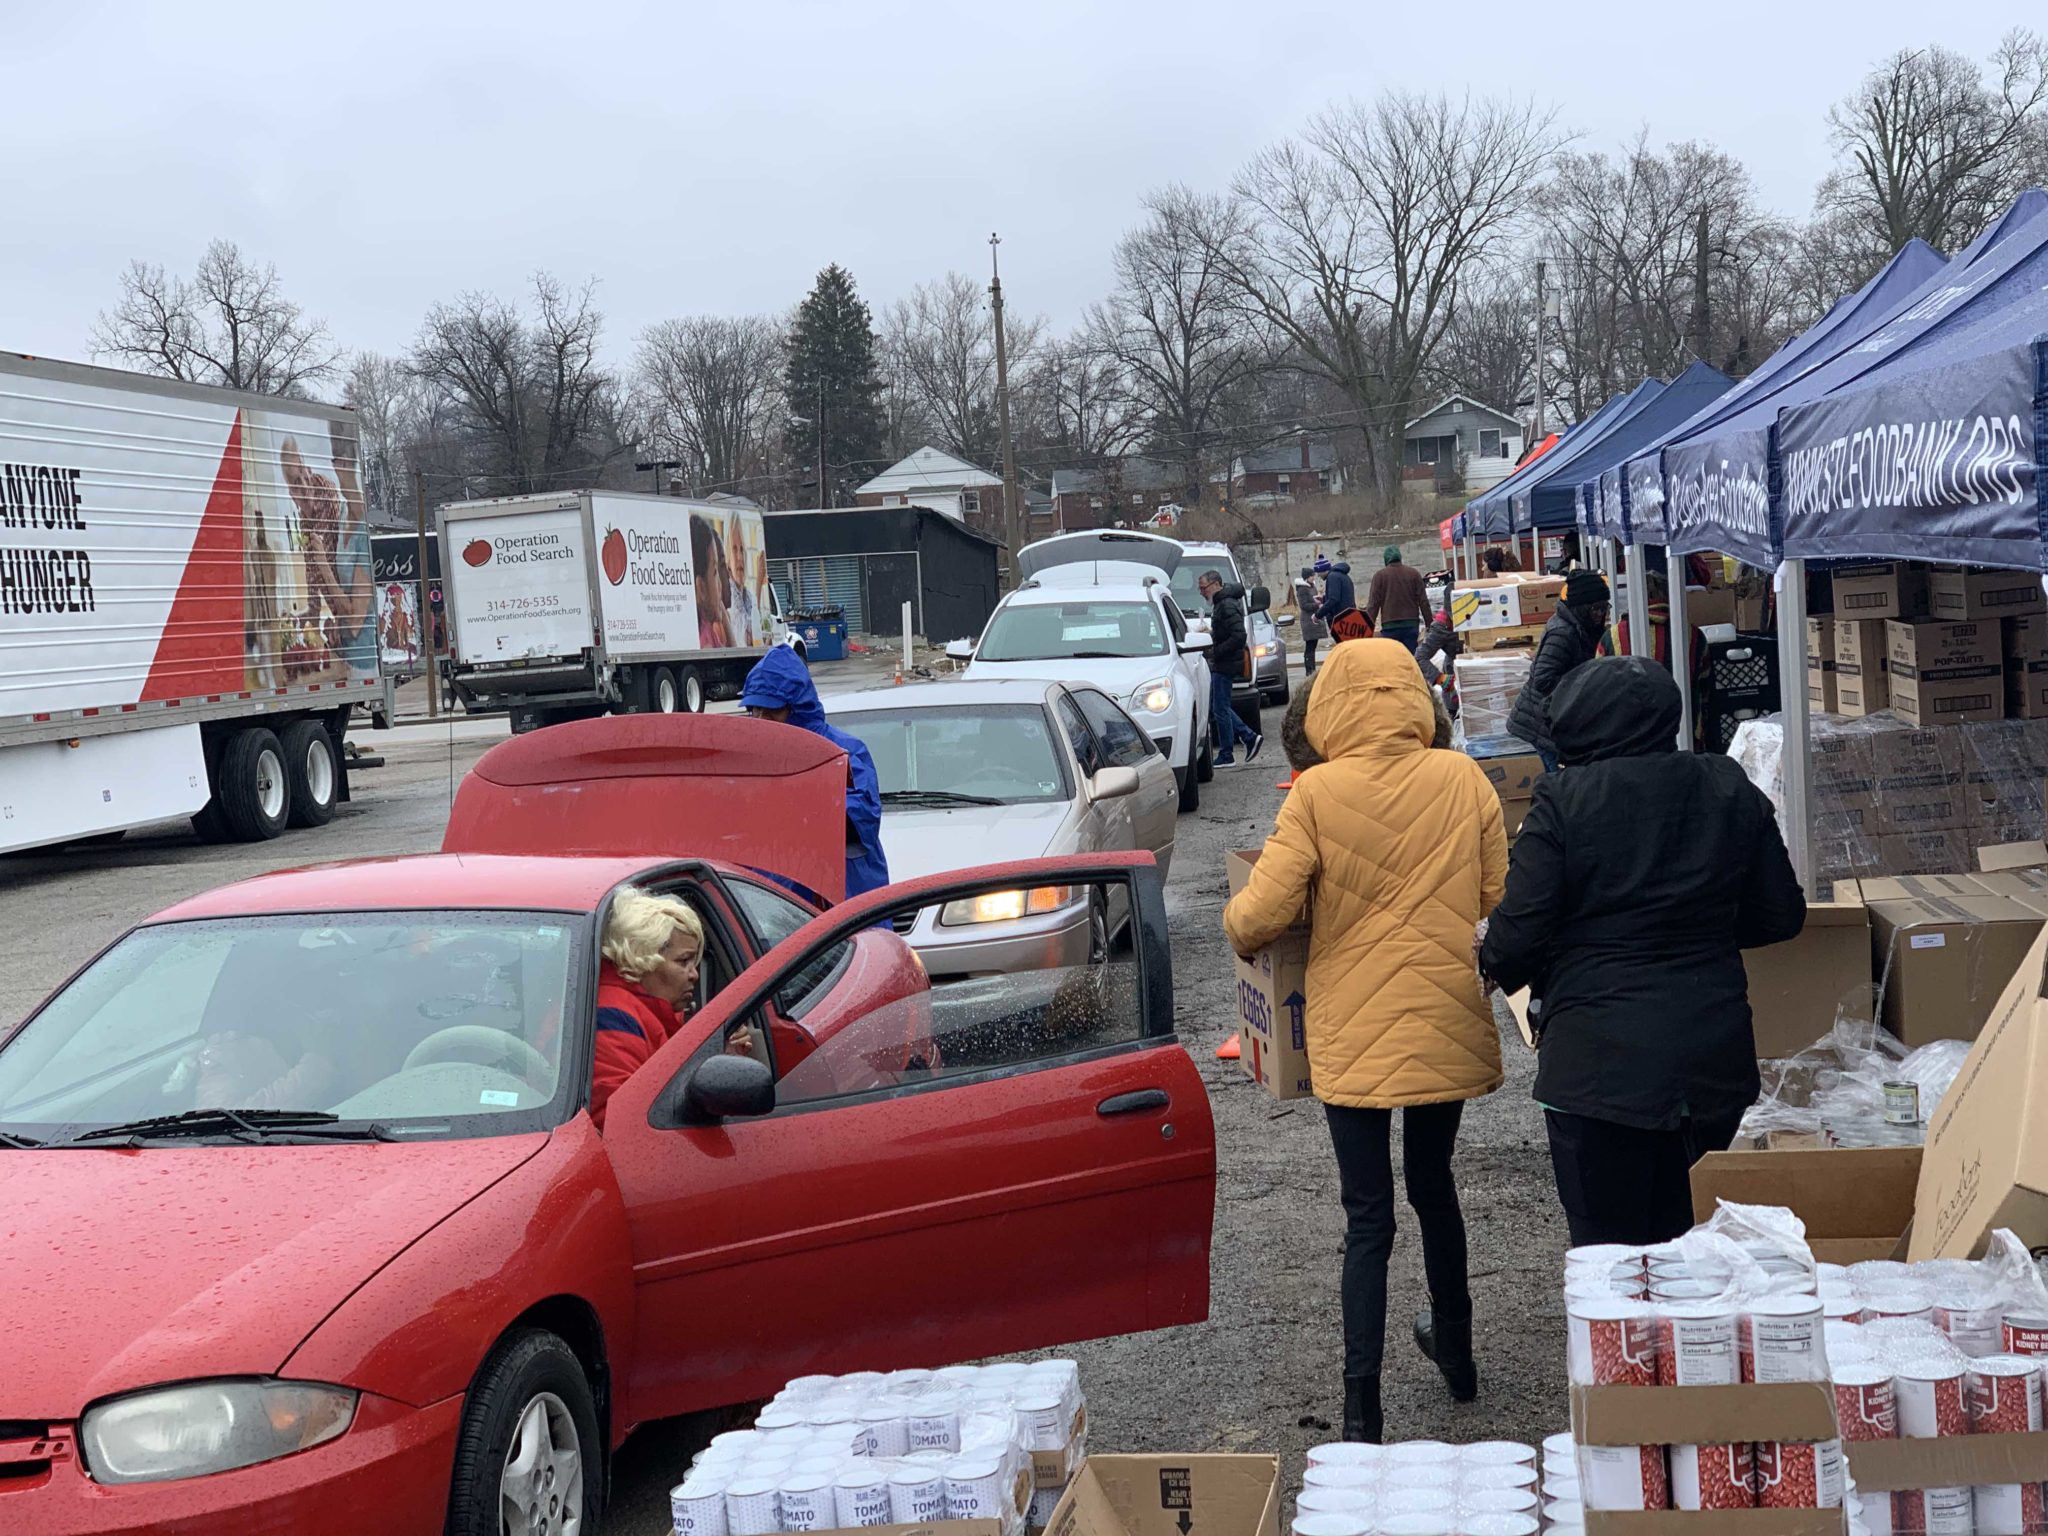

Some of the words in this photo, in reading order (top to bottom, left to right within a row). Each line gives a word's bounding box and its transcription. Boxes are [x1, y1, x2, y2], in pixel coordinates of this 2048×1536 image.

[494, 533, 559, 552] Operation
[628, 528, 680, 560] Operation
[496, 551, 527, 565] Food
[530, 546, 574, 561] Search
[0, 550, 95, 614] HUNGER
[630, 561, 657, 585] Food
[658, 562, 692, 586] Search
[487, 595, 559, 611] 314-726-5355
[467, 606, 581, 624] www.OperationFoodSearch.org
[1337, 620, 1367, 638] SLOW
[1934, 655, 1984, 667] POP-TARTS
[1241, 978, 1267, 1035] EGGS
[1297, 1079, 1312, 1092] KE
[2016, 1340, 2039, 1350] KIDNEY
[2022, 1332, 2040, 1341] DARK
[911, 1433, 950, 1446] TOMATO
[854, 1499, 891, 1518] TOMAT
[912, 1496, 944, 1514] TOMA
[948, 1498, 978, 1510] MATO
[784, 1510, 815, 1522] MATO
